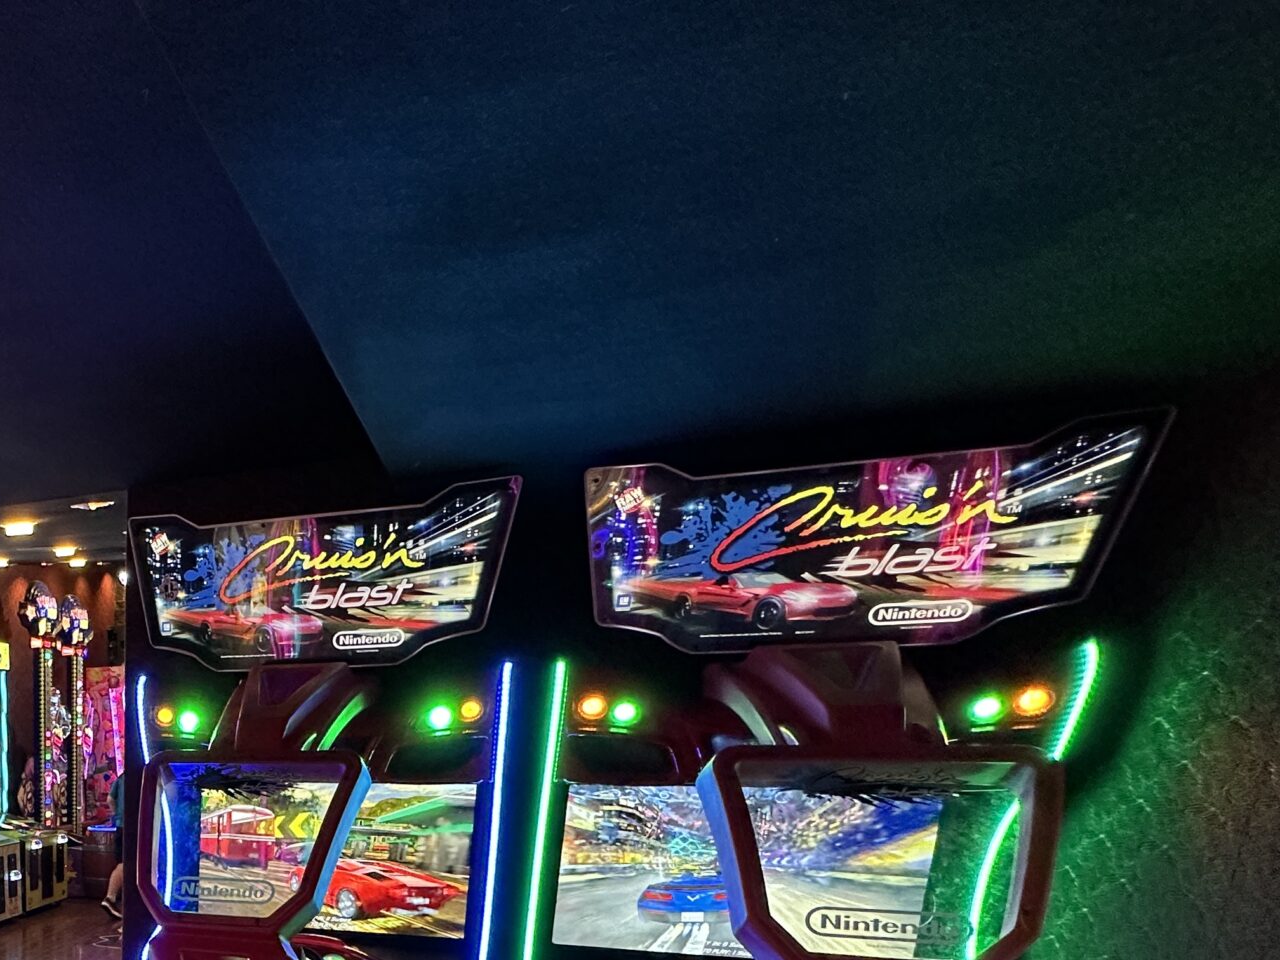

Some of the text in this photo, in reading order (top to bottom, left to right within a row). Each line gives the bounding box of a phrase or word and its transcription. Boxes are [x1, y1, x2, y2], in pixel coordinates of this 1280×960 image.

[711, 480, 1020, 572] Cruis'n
[221, 532, 426, 603] Cruis'n
[830, 538, 997, 579] blast
[300, 579, 417, 611] blast
[876, 606, 962, 622] Nintendo
[338, 632, 399, 647] Nintendo
